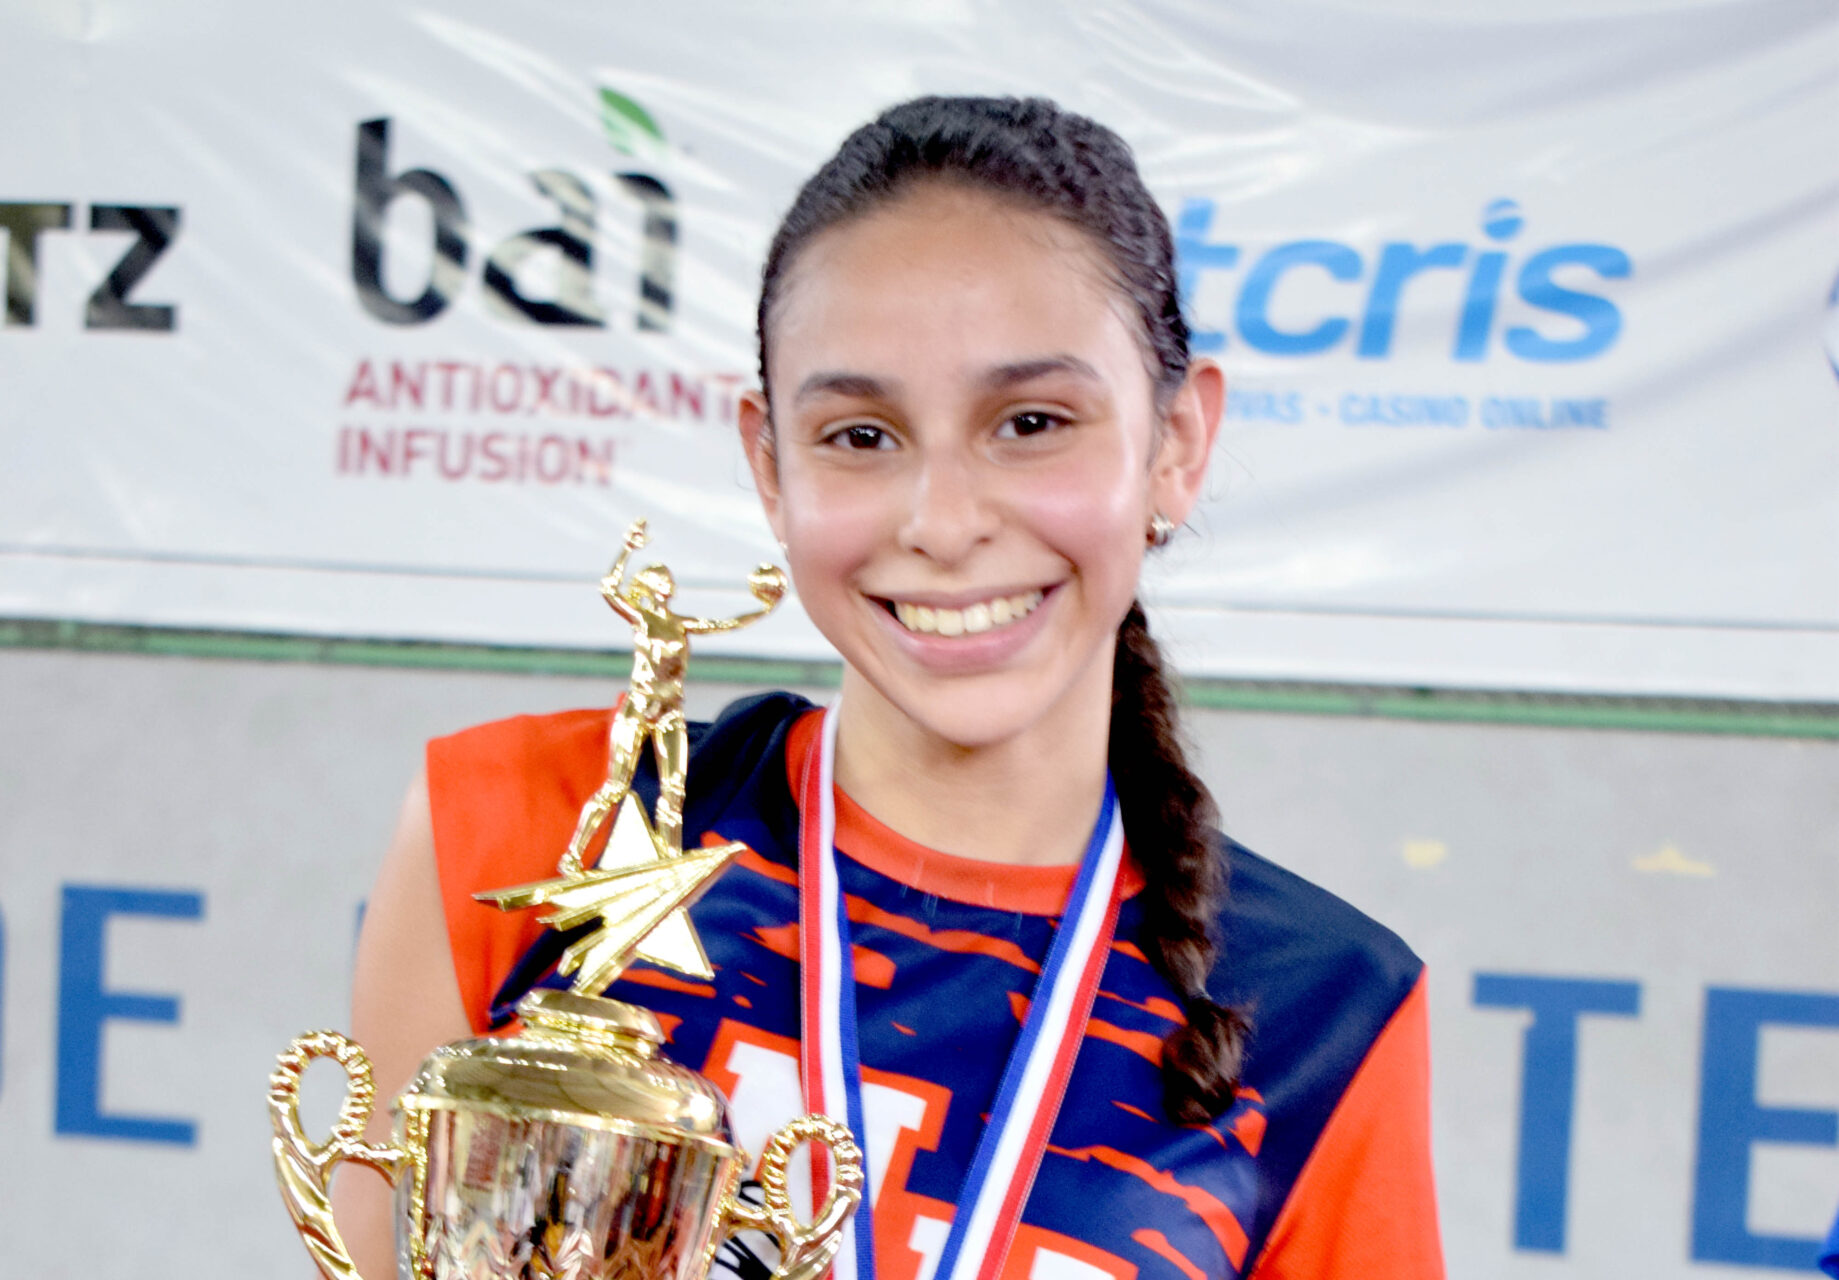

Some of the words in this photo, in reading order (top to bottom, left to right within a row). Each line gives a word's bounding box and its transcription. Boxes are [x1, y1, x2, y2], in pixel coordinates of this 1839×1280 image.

[350, 87, 680, 332] bai
[0, 203, 181, 333] TZ
[335, 424, 617, 486] INFUSION
[1339, 393, 1468, 428] CASINO
[1480, 396, 1610, 431] ONLINE
